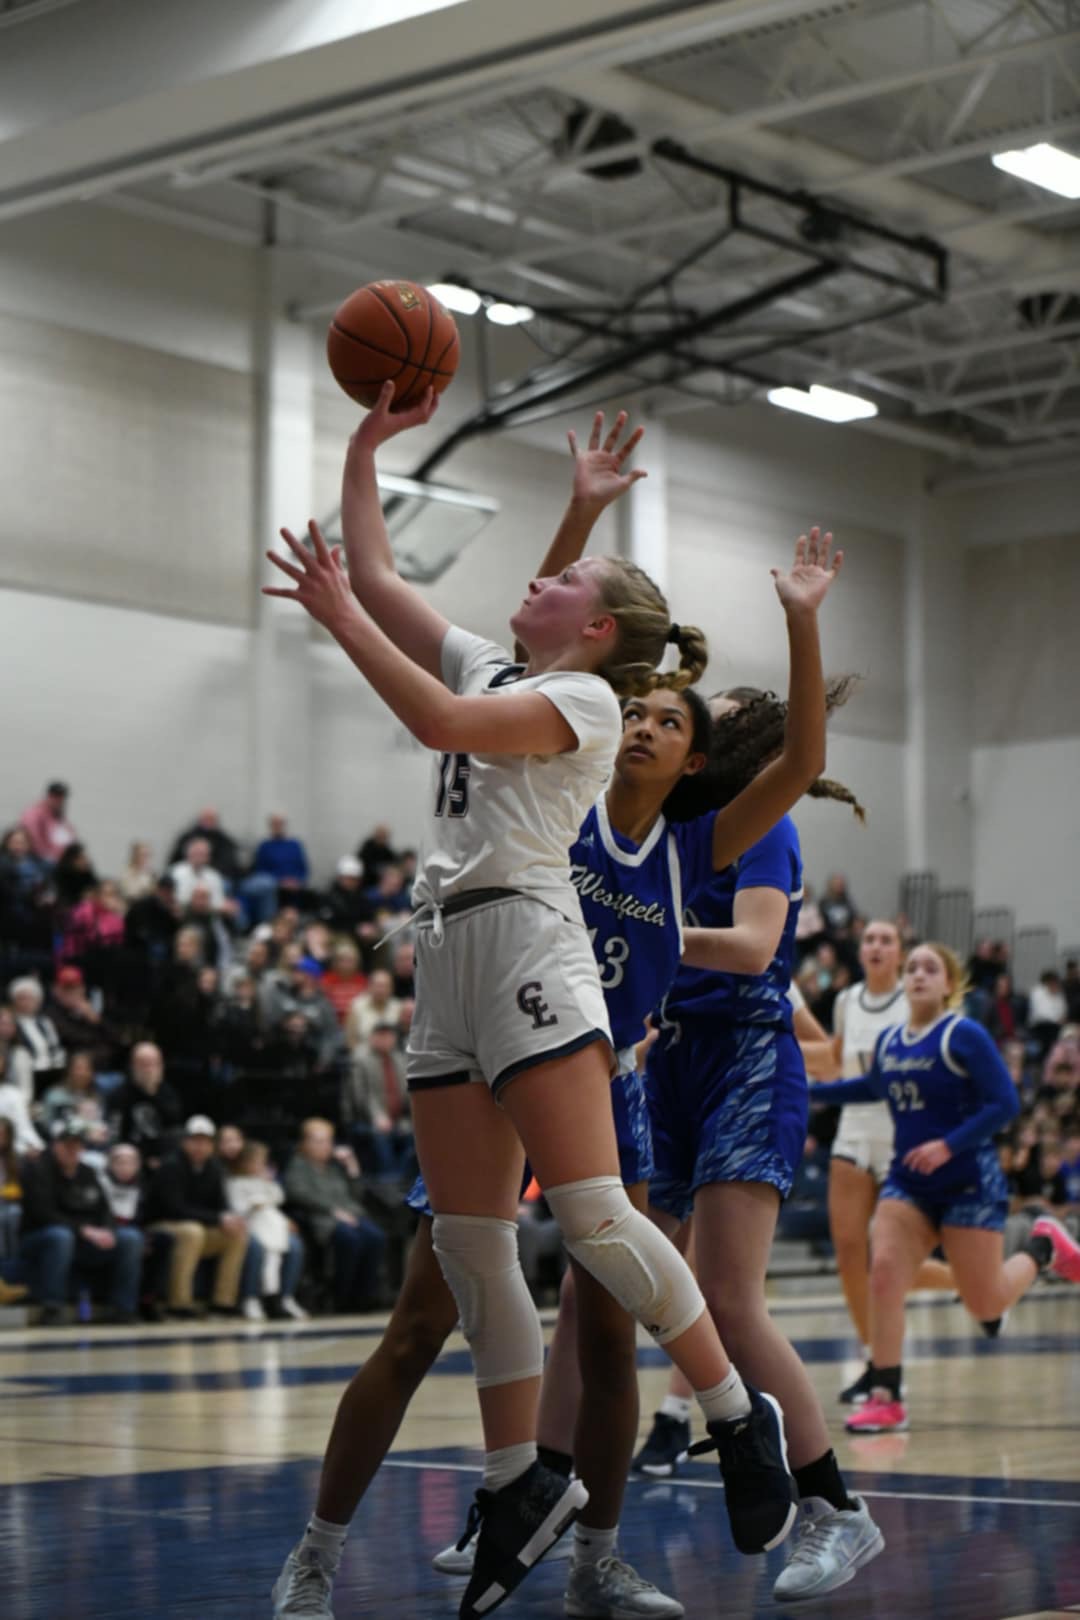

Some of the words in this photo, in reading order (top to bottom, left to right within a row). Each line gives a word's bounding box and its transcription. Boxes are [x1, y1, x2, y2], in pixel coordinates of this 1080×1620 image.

[434, 752, 470, 818] 15
[569, 864, 666, 927] Westfield
[588, 927, 630, 989] 3
